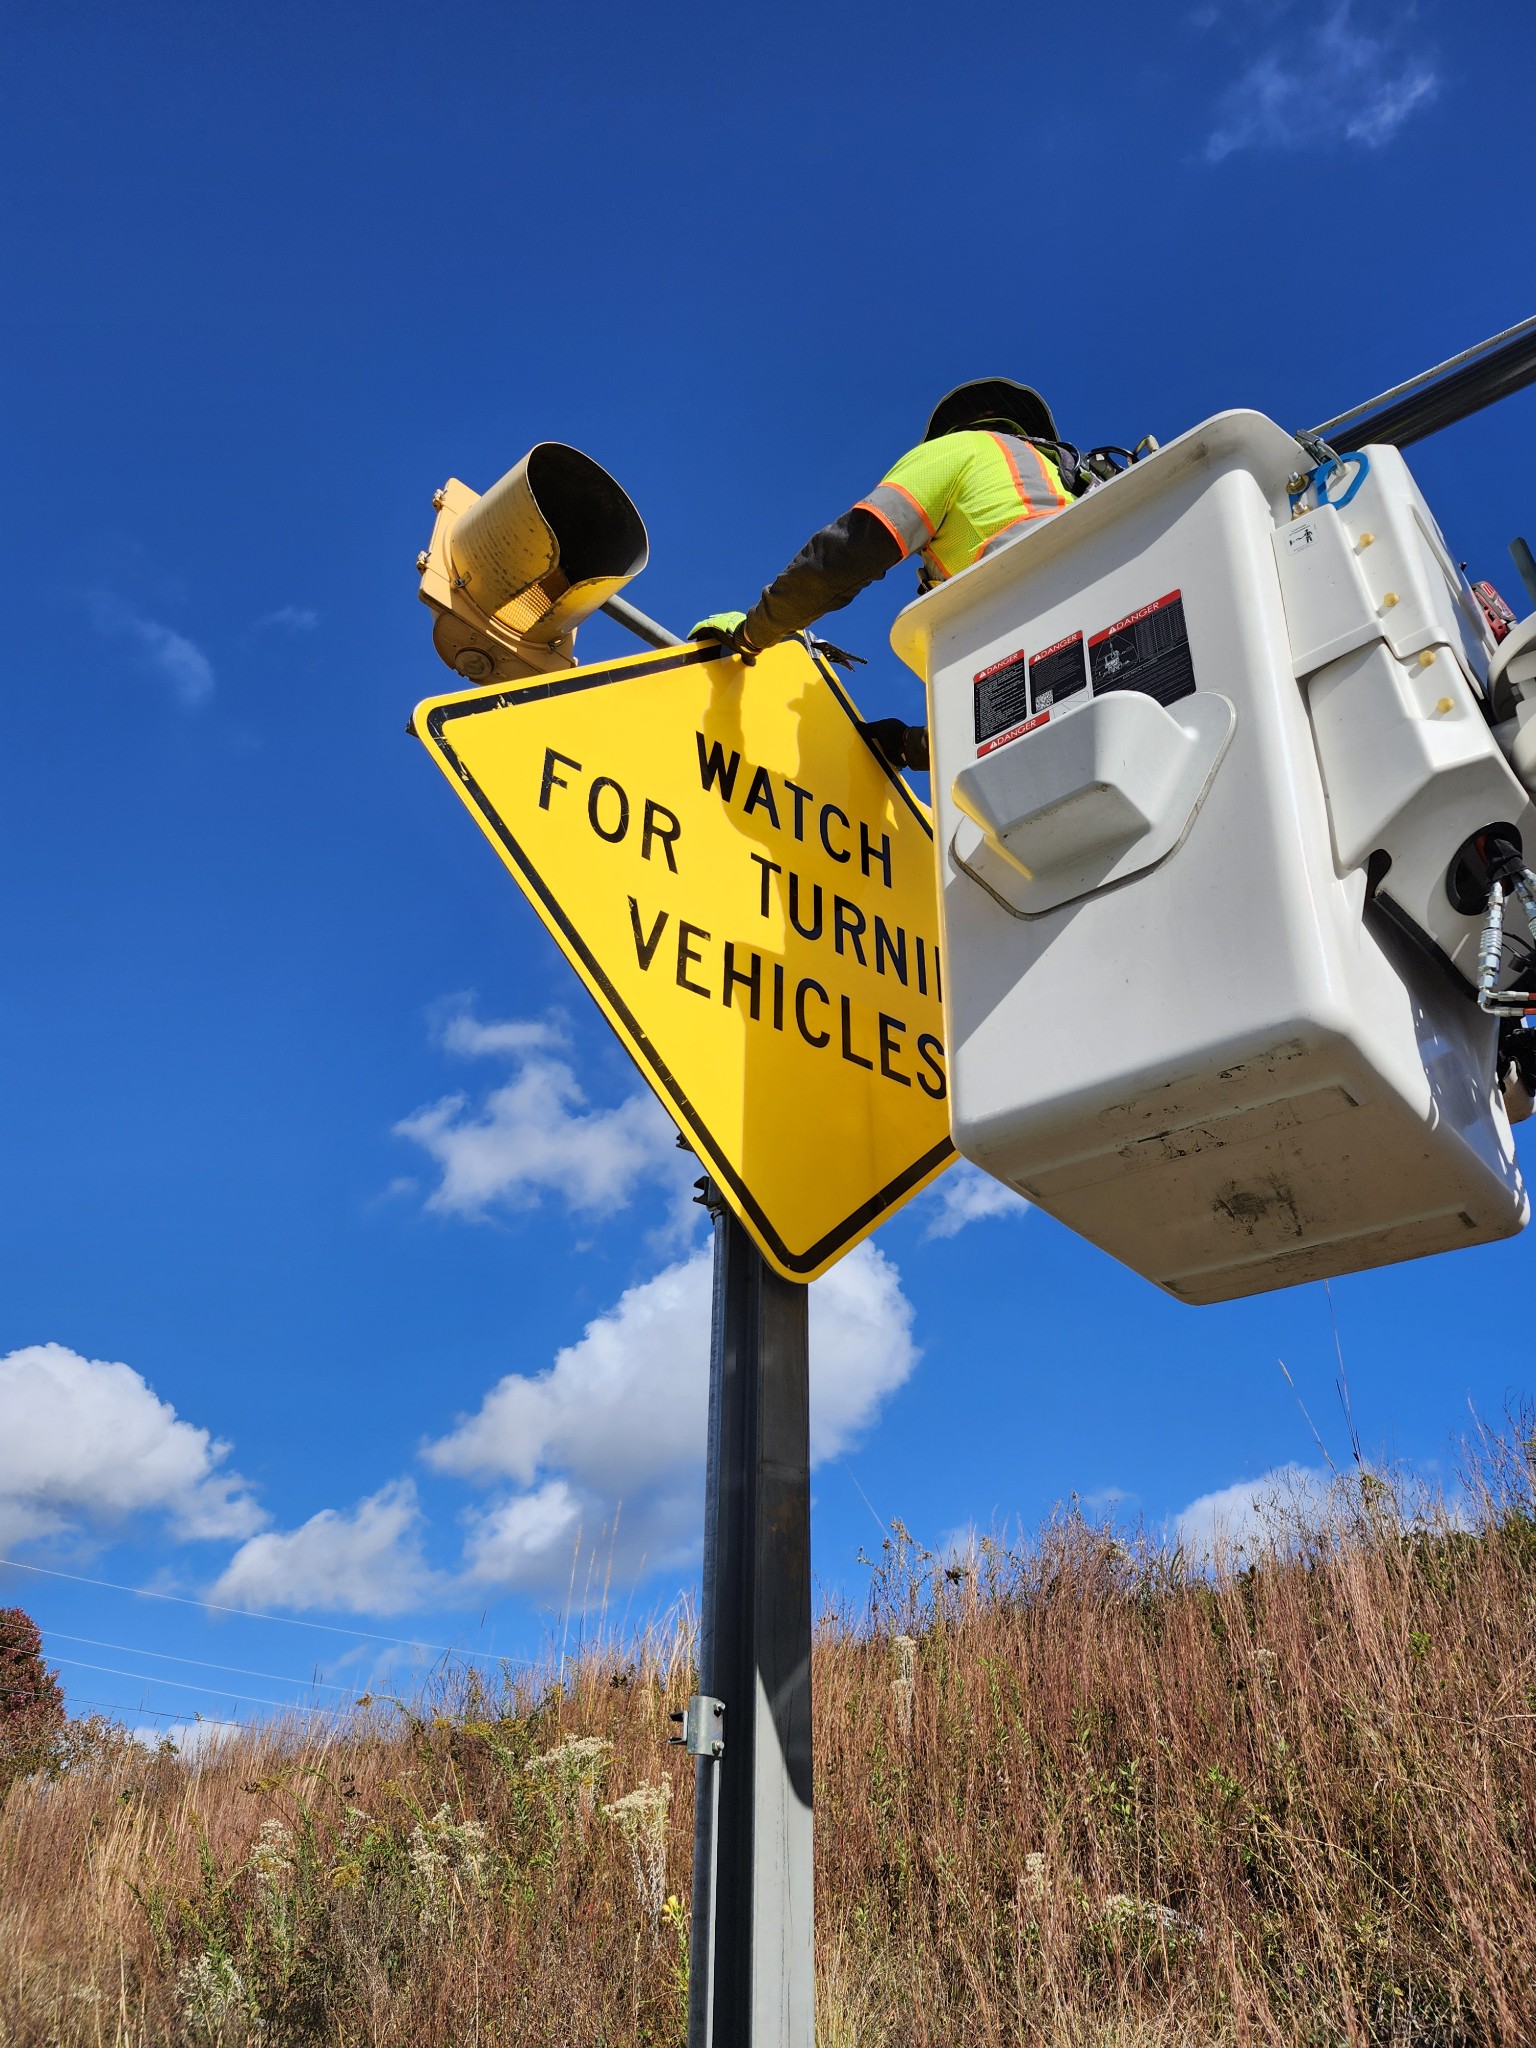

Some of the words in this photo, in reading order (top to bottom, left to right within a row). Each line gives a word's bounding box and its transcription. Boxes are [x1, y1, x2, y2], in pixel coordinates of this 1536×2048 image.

[1116, 601, 1159, 631] DANGER
[1040, 634, 1077, 657] DANGER
[986, 653, 1018, 674] DANGER
[997, 719, 1036, 746] DANGER
[695, 731, 893, 889] WATCH
[539, 746, 682, 874] FOR
[750, 852, 943, 1003] TURNI
[627, 895, 947, 1100] VEHICLES
